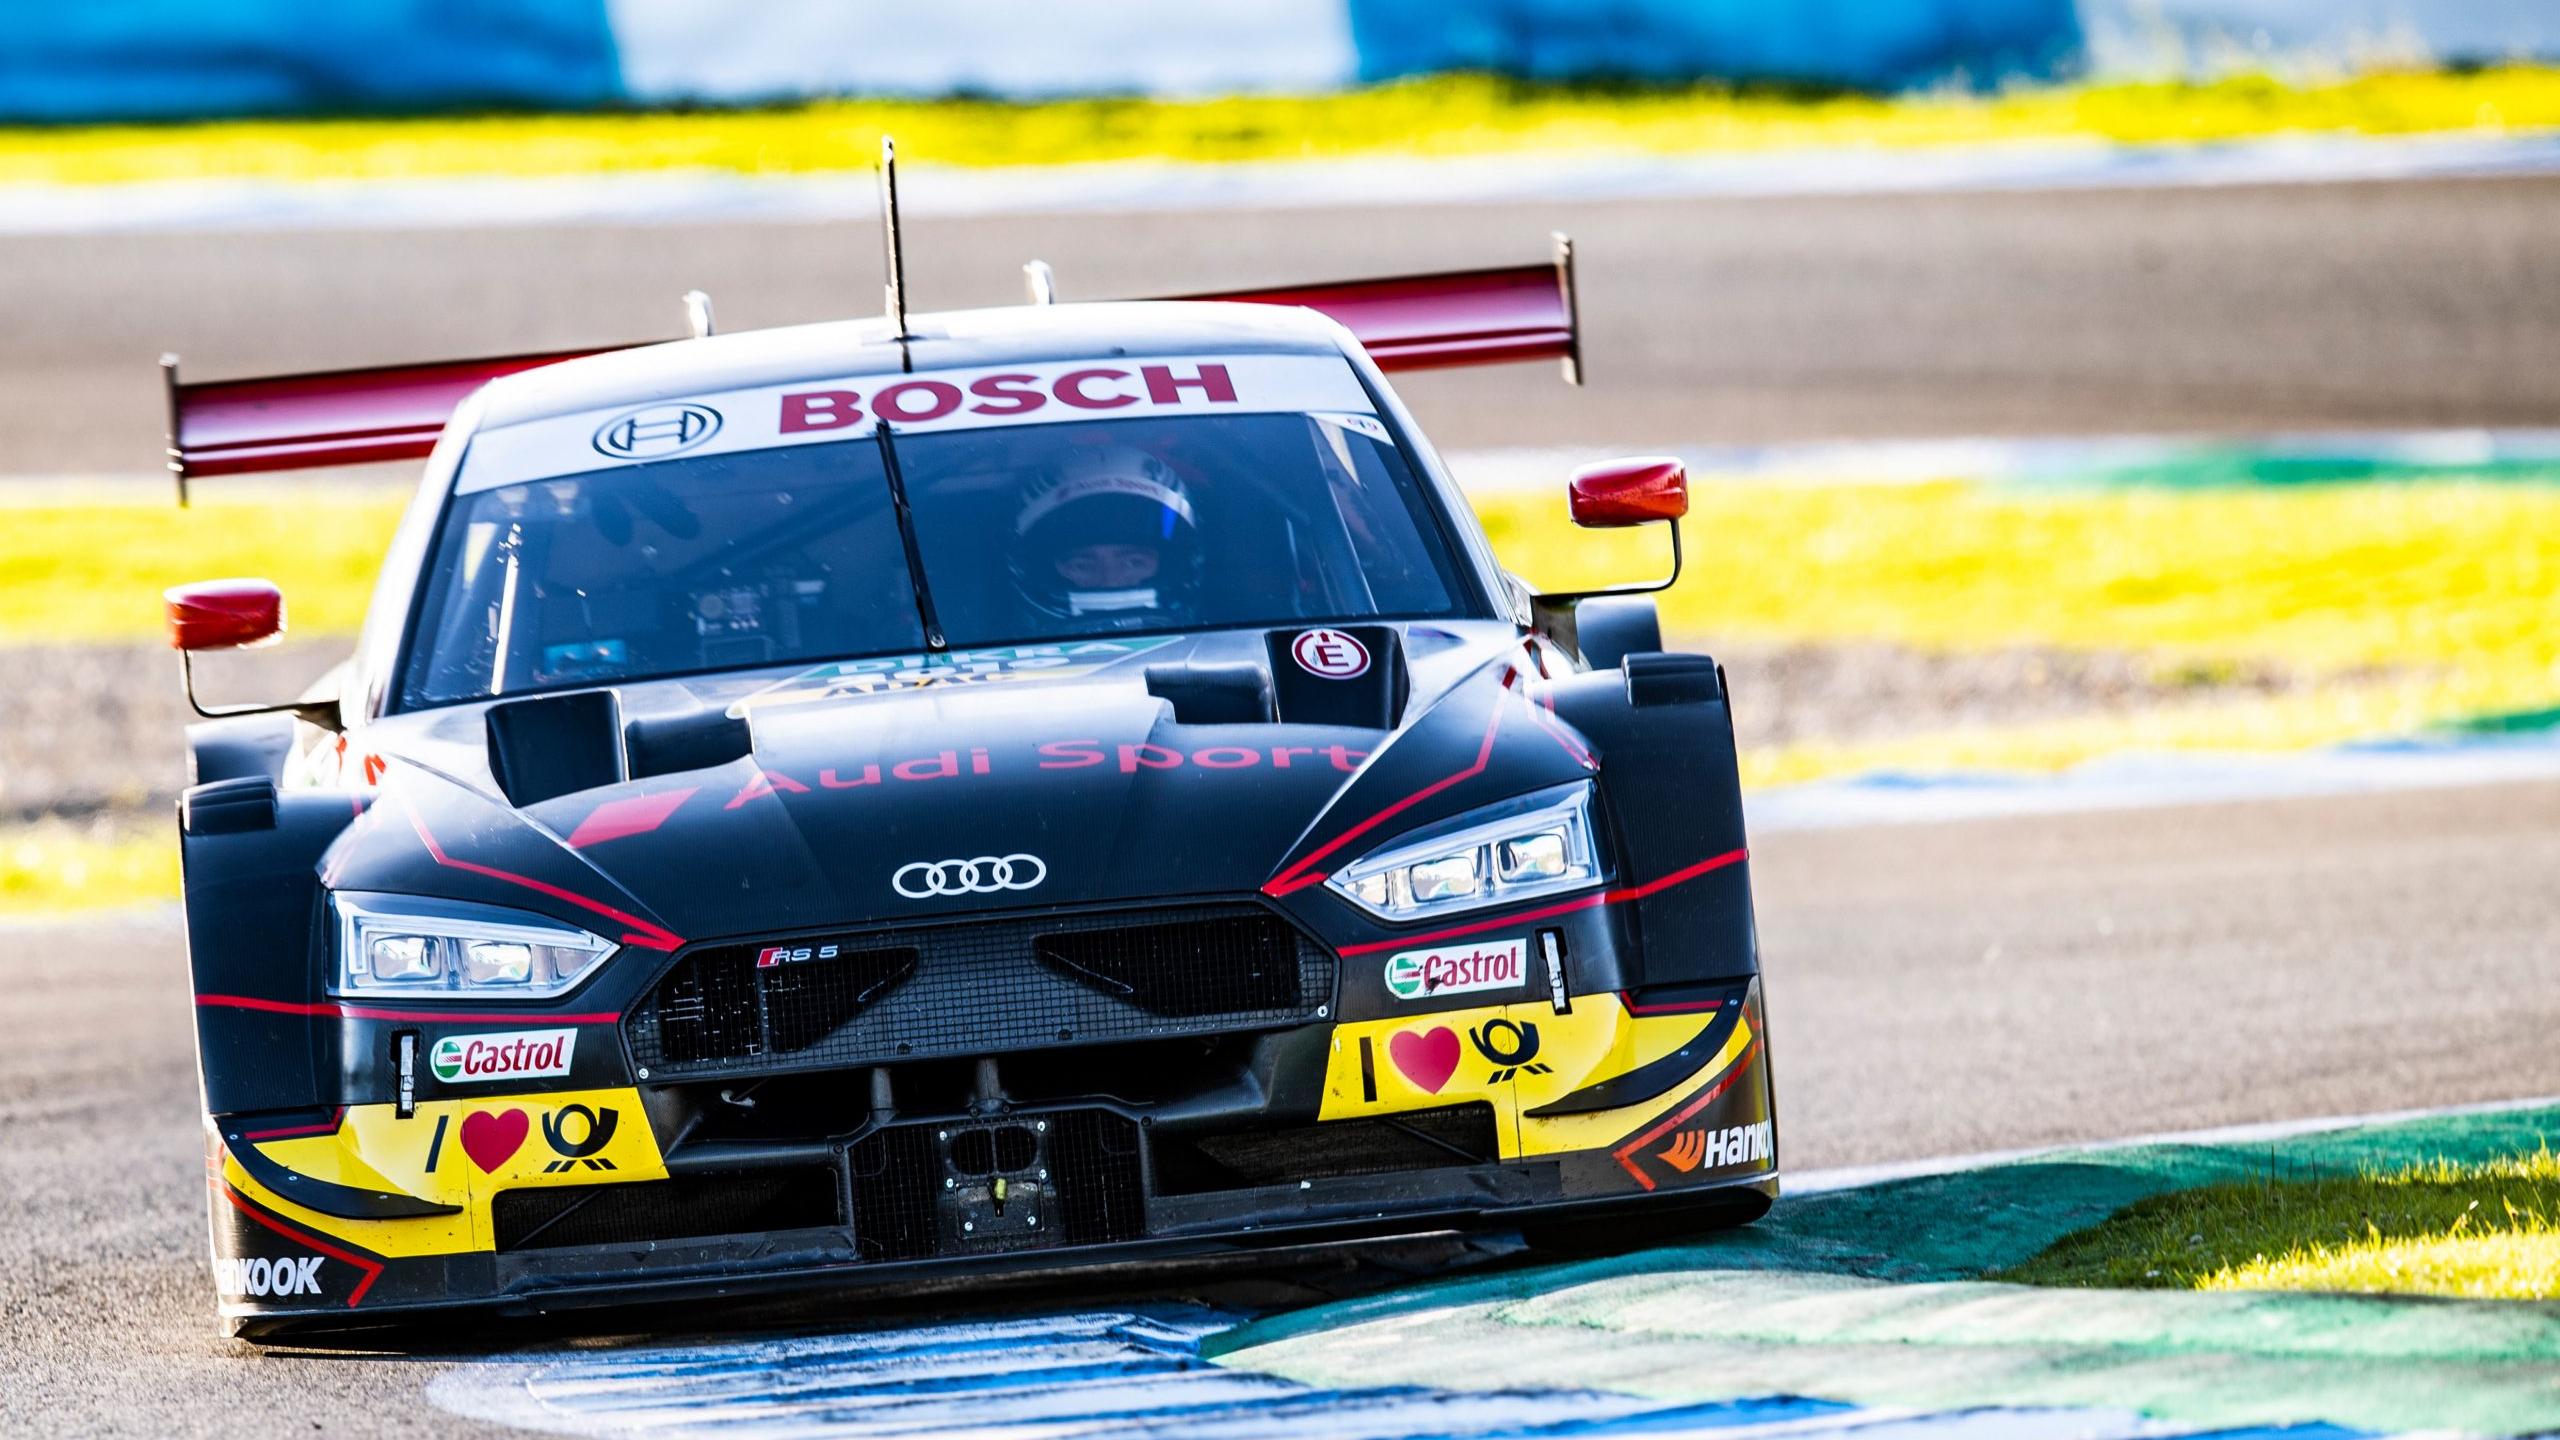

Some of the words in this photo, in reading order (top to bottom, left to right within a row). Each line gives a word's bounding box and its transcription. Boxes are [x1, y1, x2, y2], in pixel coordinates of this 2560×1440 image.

[779, 363, 1239, 435] BOSCH
[723, 746, 990, 810] Audi
[1038, 740, 1370, 774] Sport
[770, 947, 812, 964] RS
[818, 944, 839, 959] 5
[1423, 946, 1520, 991] Castrol
[464, 1035, 565, 1076] Castrol
